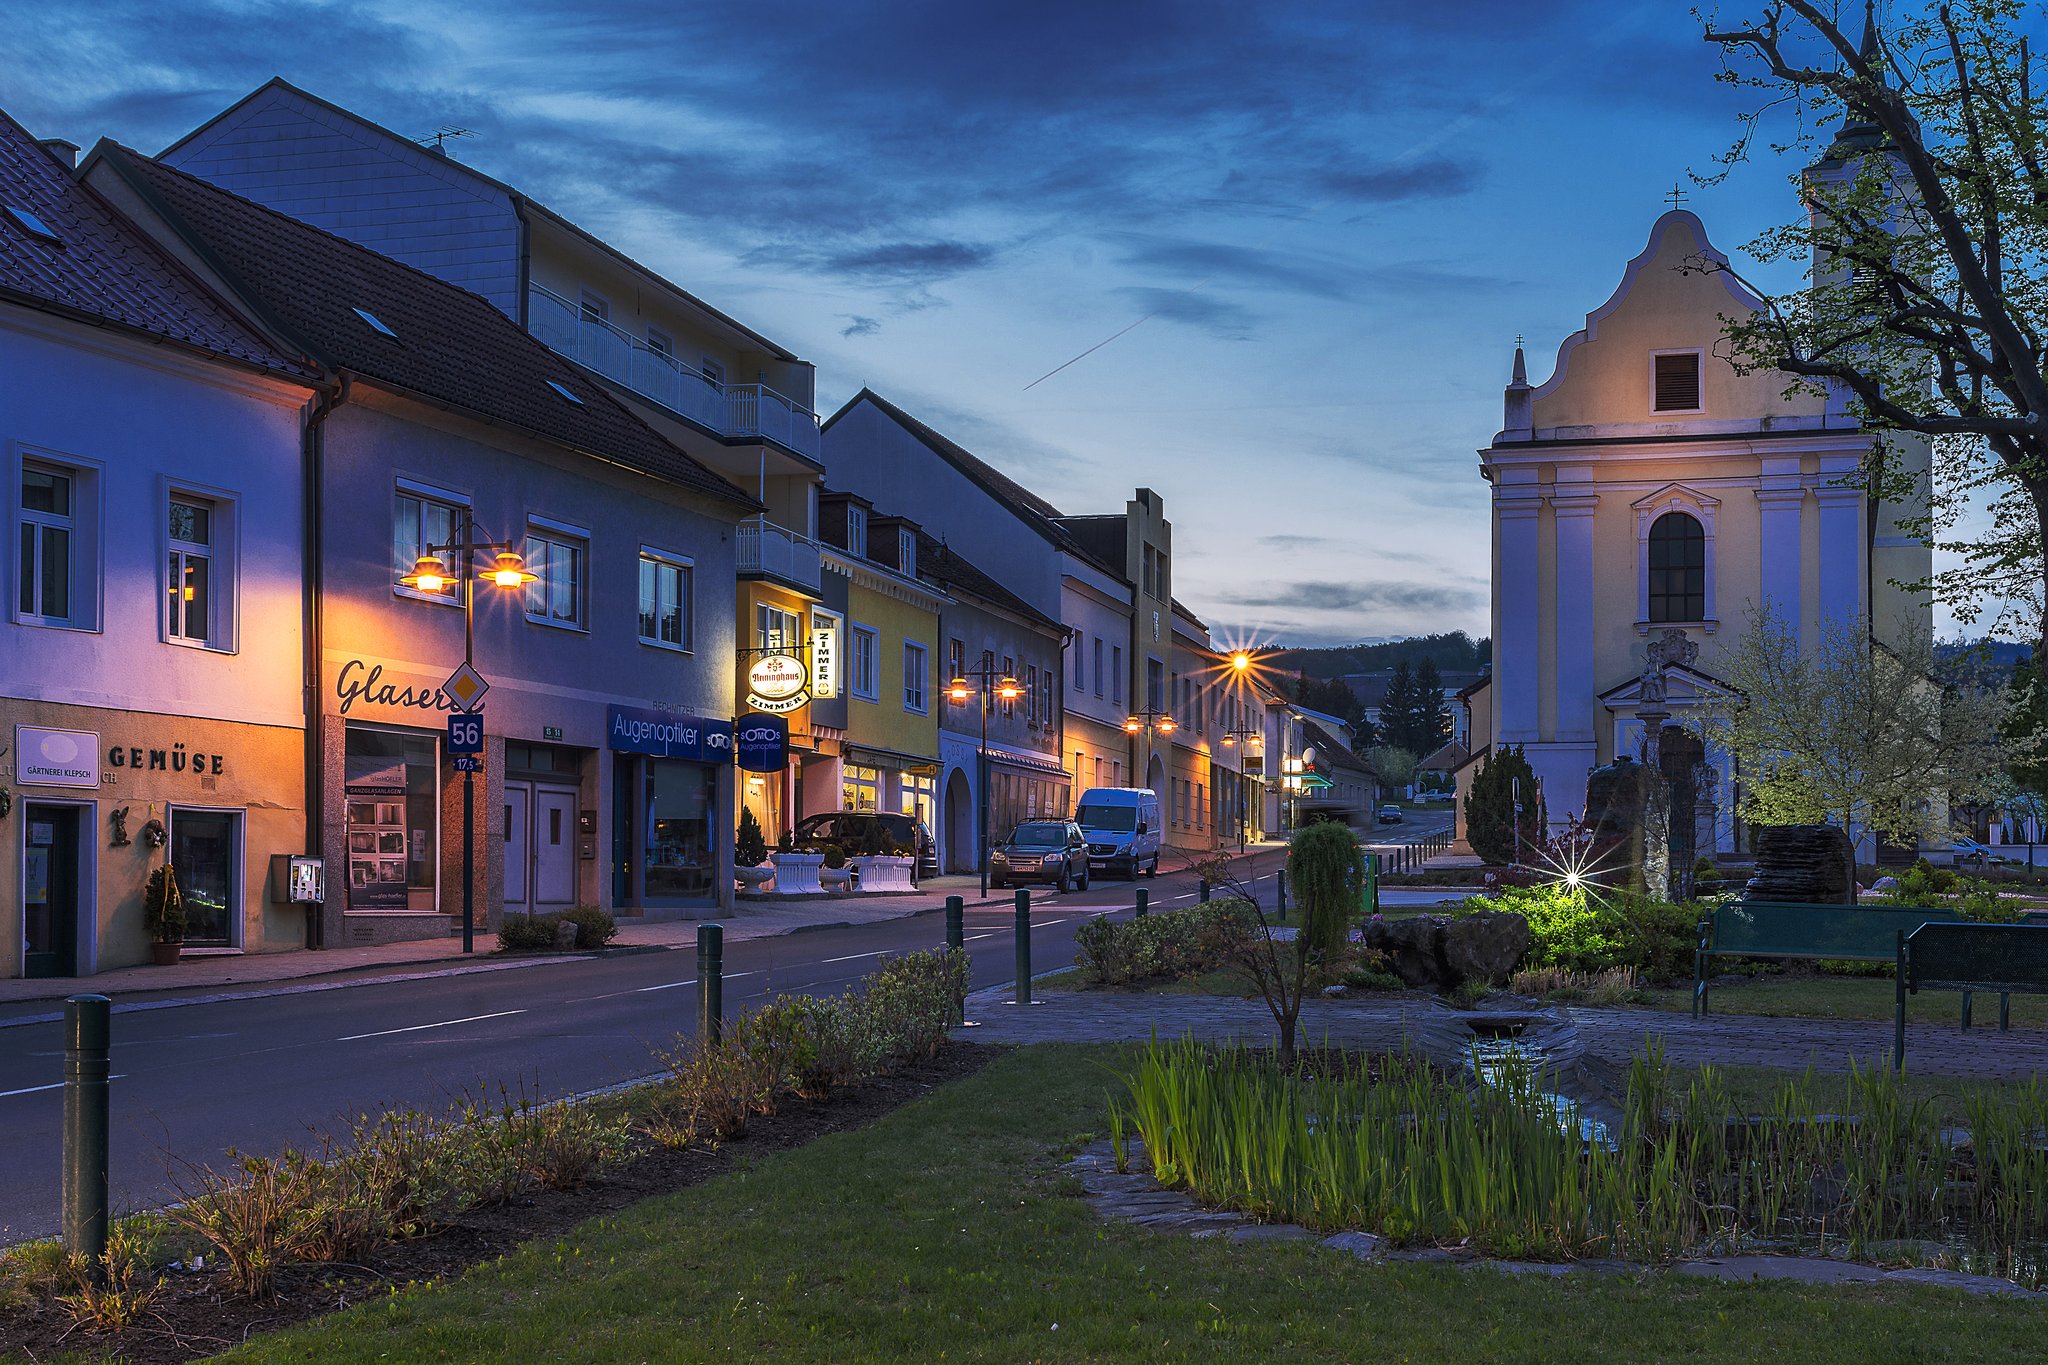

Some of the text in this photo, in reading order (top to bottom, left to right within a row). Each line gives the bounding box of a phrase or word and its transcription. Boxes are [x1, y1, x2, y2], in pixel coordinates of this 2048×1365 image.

[818, 633, 829, 680] ZIMMER
[337, 660, 486, 714] Glaser
[750, 696, 802, 710] ZIMMER
[452, 722, 478, 745] 56
[614, 713, 698, 752] Augenoptiker
[740, 727, 781, 742] SOMOS
[740, 742, 781, 752] Augenoptiker
[109, 742, 224, 775] GEMÜSE
[457, 758, 474, 771] 17,5
[27, 765, 91, 778] GÄRTNEREI KLEPSCH
